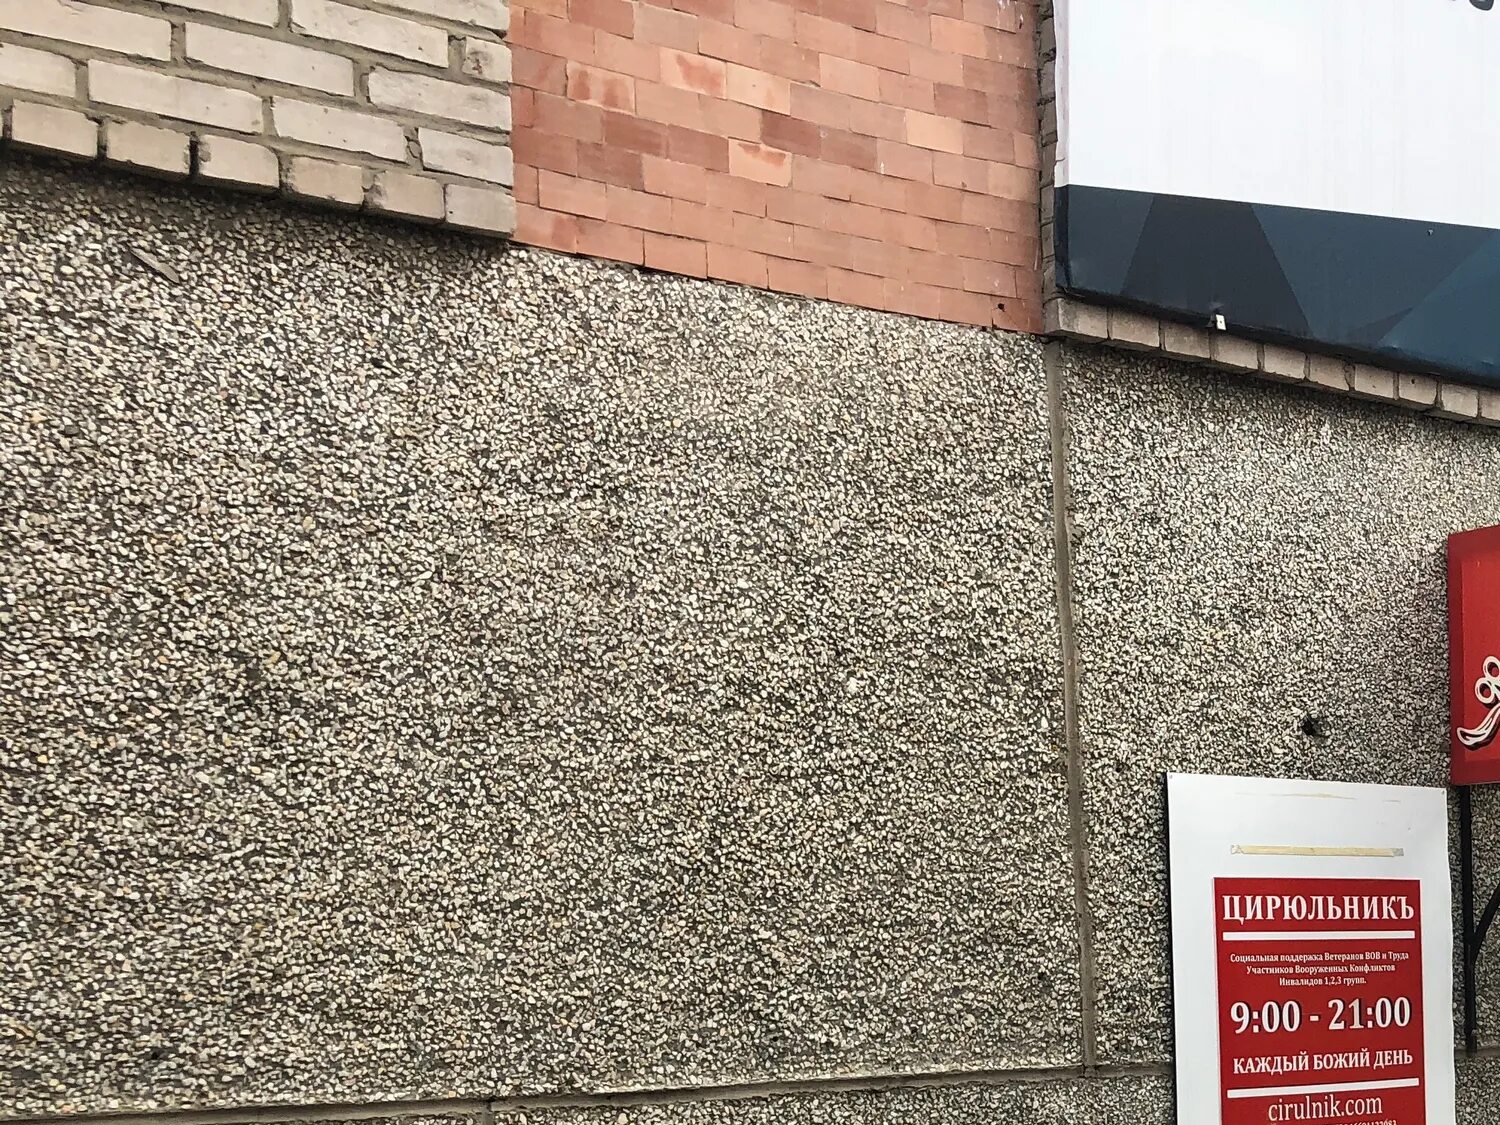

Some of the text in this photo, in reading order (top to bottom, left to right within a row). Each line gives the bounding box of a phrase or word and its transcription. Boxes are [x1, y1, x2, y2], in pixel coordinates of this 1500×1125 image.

[1222, 895, 1415, 925] ЦИРЮЛЬНИКЪ
[1230, 953, 1278, 963] Социальная
[1280, 954, 1323, 963] поддержка
[1324, 952, 1364, 963] Ветеранов
[1365, 951, 1381, 960] ВОВ
[1387, 951, 1409, 962] Труда
[1246, 963, 1395, 975] Участников Вооруженных Конфликтов
[1279, 977, 1323, 987] Инвалидов
[1324, 976, 1342, 986] 1,2,3
[1230, 1001, 1300, 1033] 9:00
[1328, 997, 1411, 1030] 21:00
[1233, 1048, 1413, 1075] КАЖДЫЙ БОЖИЙ ДЕНЬ
[1268, 1094, 1383, 1121] cirulnik.com
